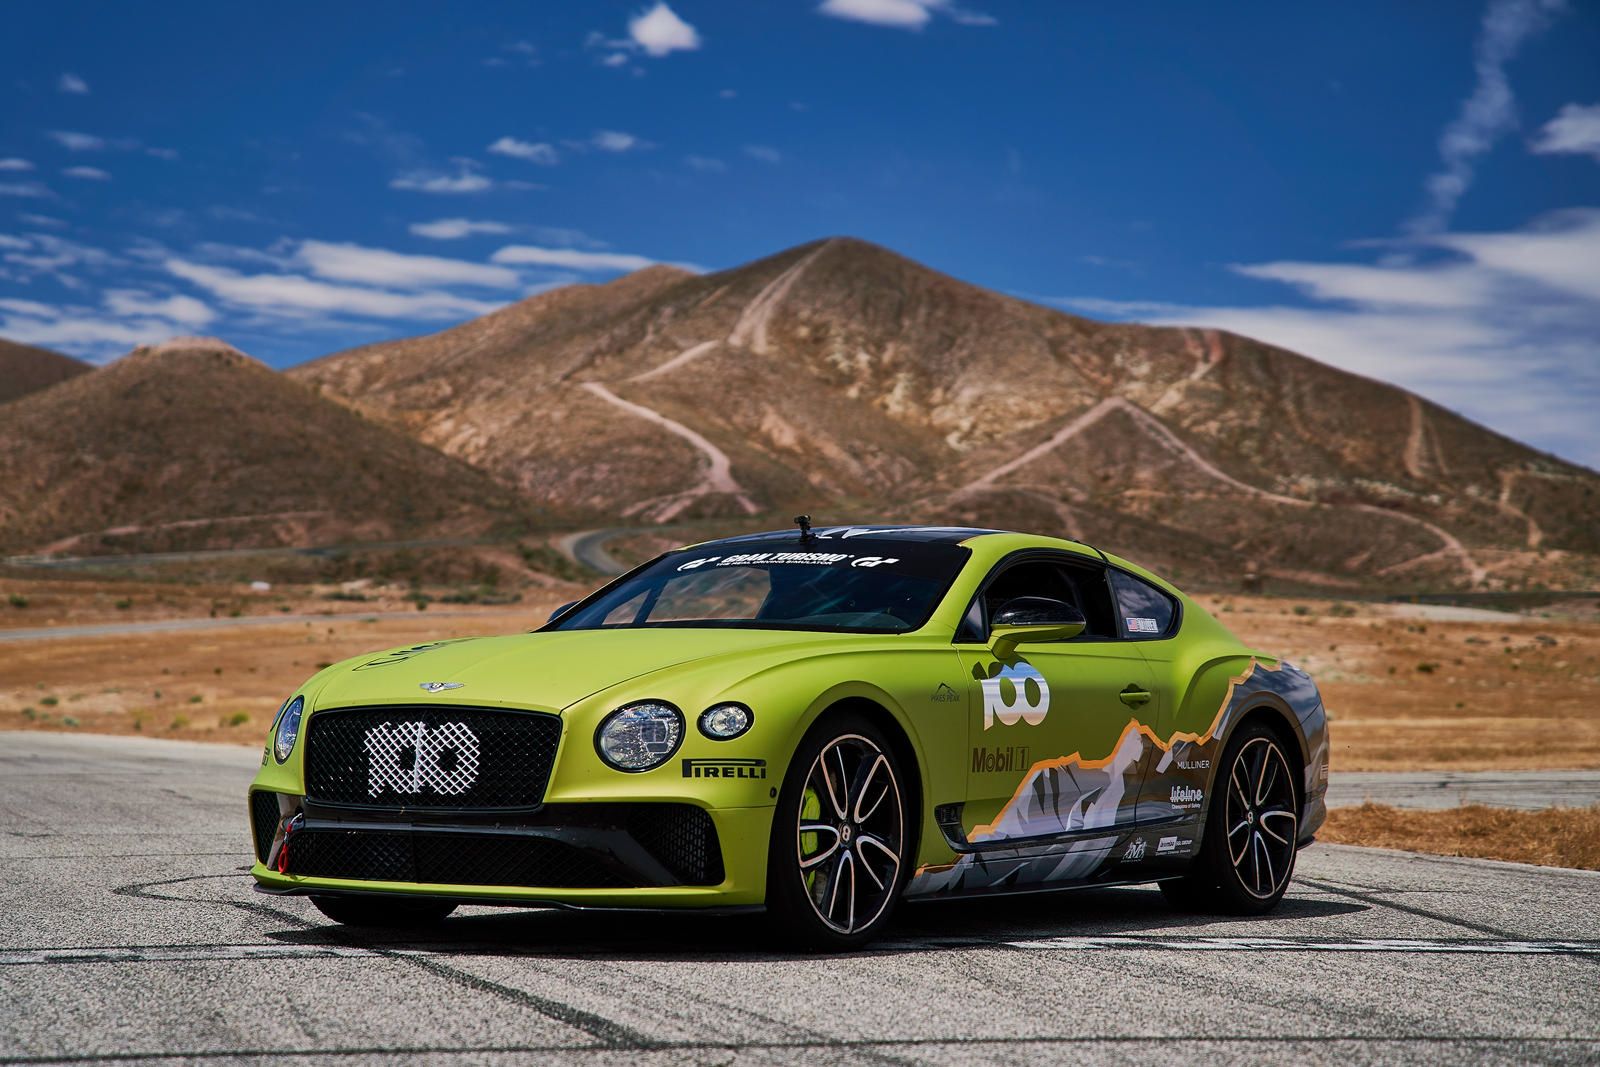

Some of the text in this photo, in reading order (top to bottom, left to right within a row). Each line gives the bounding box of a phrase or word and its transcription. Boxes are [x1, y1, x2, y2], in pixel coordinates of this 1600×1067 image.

[721, 552, 848, 564] GRAN TURISMO
[682, 758, 767, 779] PIRELLI
[971, 747, 1014, 773] Mobil
[1176, 760, 1210, 770] MULLINER
[1170, 785, 1203, 803] lifeline
